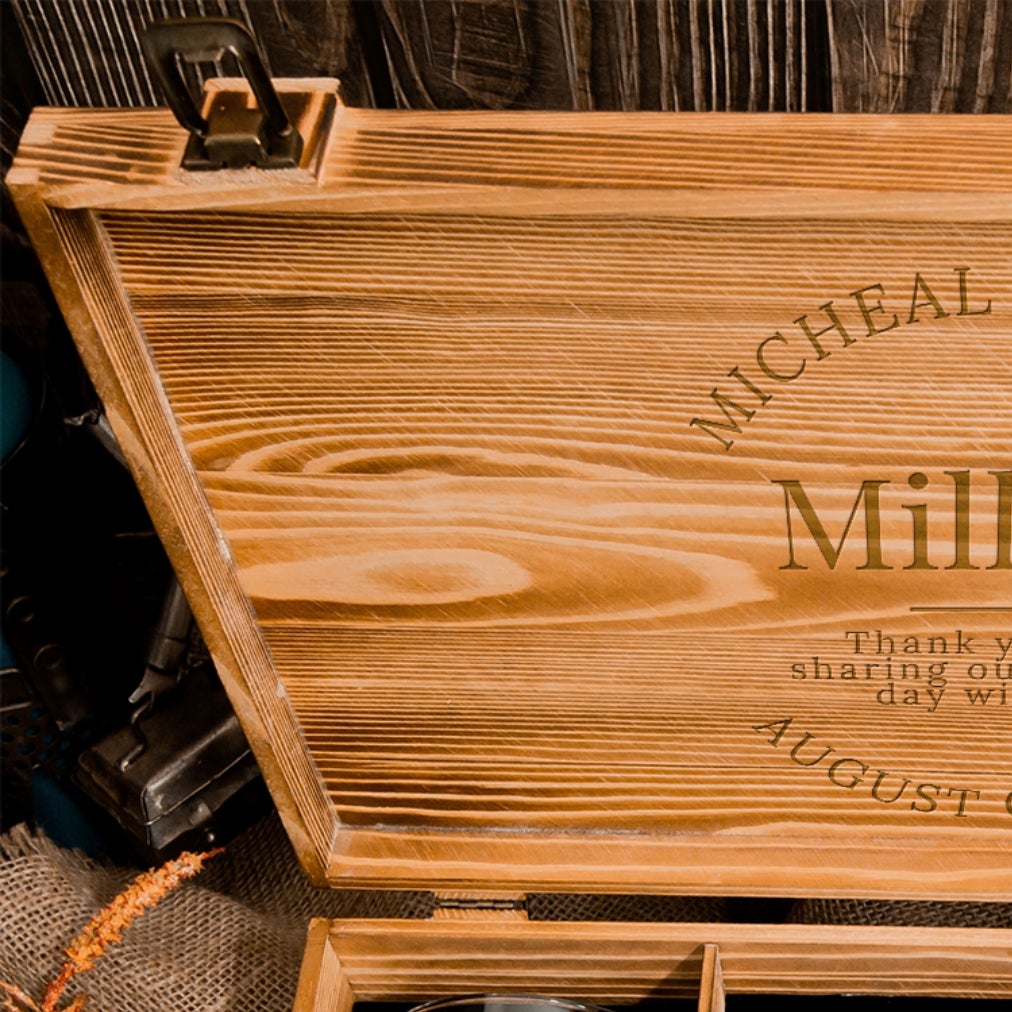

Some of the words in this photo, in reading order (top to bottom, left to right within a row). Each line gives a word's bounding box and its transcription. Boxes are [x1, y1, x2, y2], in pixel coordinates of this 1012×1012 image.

[690, 266, 992, 450] MICHEAL
[845, 630, 975, 656] Thank
[791, 657, 949, 687] sharing
[875, 682, 946, 712] day
[753, 715, 981, 818] AUGUST
